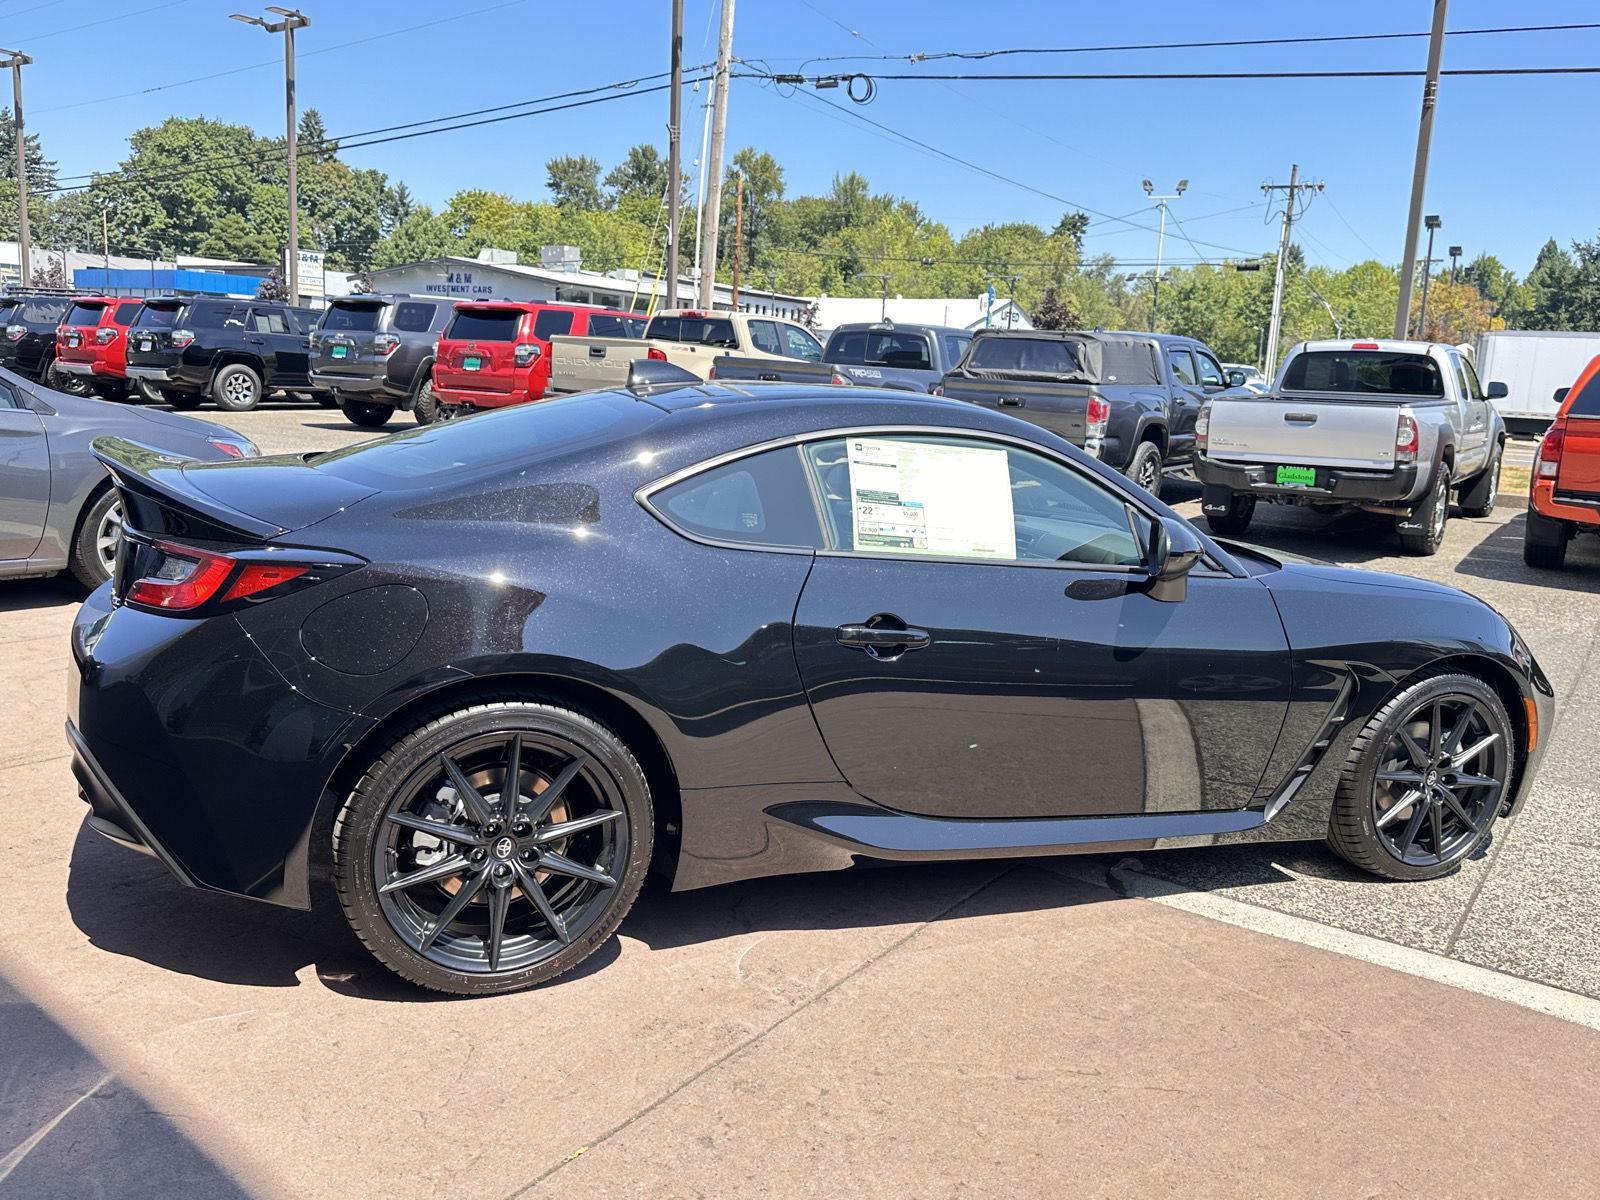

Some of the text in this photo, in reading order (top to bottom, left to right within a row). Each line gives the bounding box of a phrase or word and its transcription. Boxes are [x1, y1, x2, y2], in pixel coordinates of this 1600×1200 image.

[455, 274, 462, 284] &
[464, 273, 472, 284] M
[426, 285, 493, 294] INVESTMENT CARS
[555, 356, 630, 369] CHEVROLE
[1278, 472, 1314, 481] Gladstone
[862, 506, 873, 515] 22
